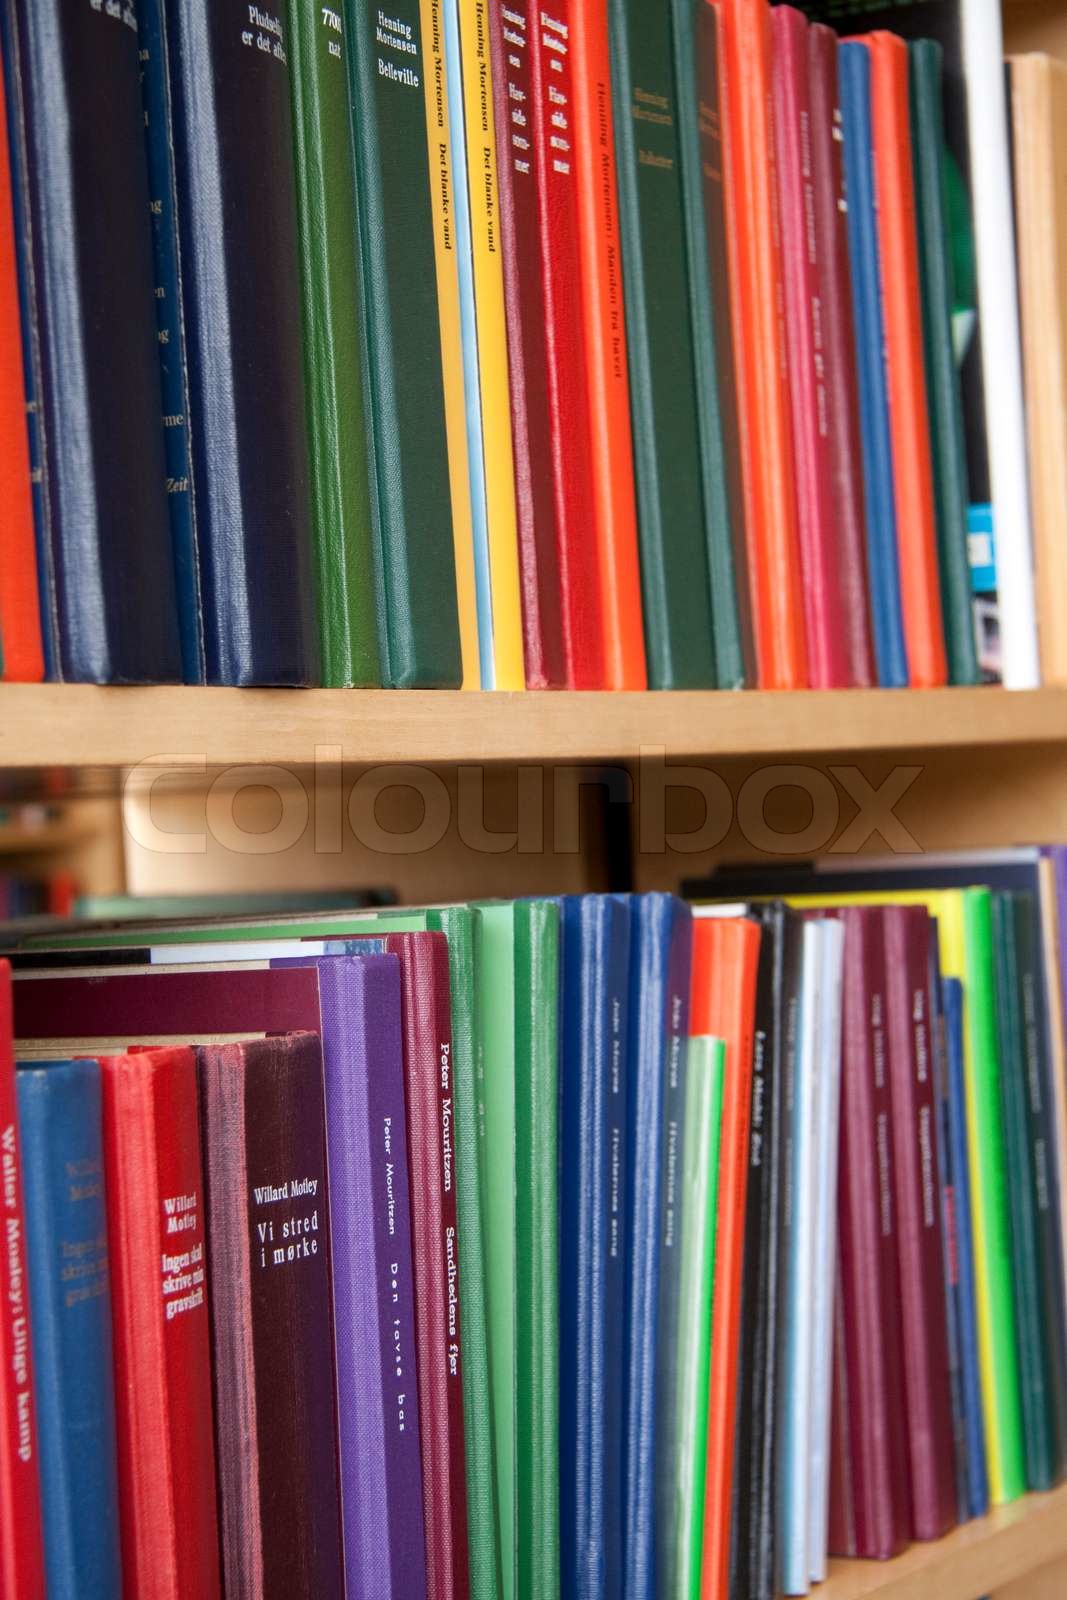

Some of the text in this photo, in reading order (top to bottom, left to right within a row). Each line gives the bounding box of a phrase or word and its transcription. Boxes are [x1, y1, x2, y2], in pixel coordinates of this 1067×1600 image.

[378, 10, 412, 39] Henning
[476, 2, 485, 58] Henning
[242, 30, 253, 46] er
[257, 33, 271, 53] det
[376, 27, 417, 55] Mortensen
[378, 58, 419, 87] Belleville
[434, 57, 445, 127] Mortensen
[478, 62, 489, 131] Mortensen
[439, 143, 447, 163] Det
[441, 169, 449, 216] blanke
[484, 170, 493, 217] blanke
[443, 220, 452, 250] vand
[487, 220, 496, 252] vand
[1, 1125, 17, 1209] Walter
[254, 1177, 318, 1205] Willard Motley
[441, 1043, 459, 1375] Peter Mouritzen Sandhedens fjer
[258, 1210, 318, 1243] Vi stred
[162, 1252, 190, 1274] Ingen
[261, 1236, 318, 1267] i mørke
[163, 1272, 192, 1294] skrive
[383, 1117, 406, 1431] Peter Mouritzen Den tavse bas
[12, 1317, 28, 1385] Ulige
[17, 1391, 32, 1462] kamp
